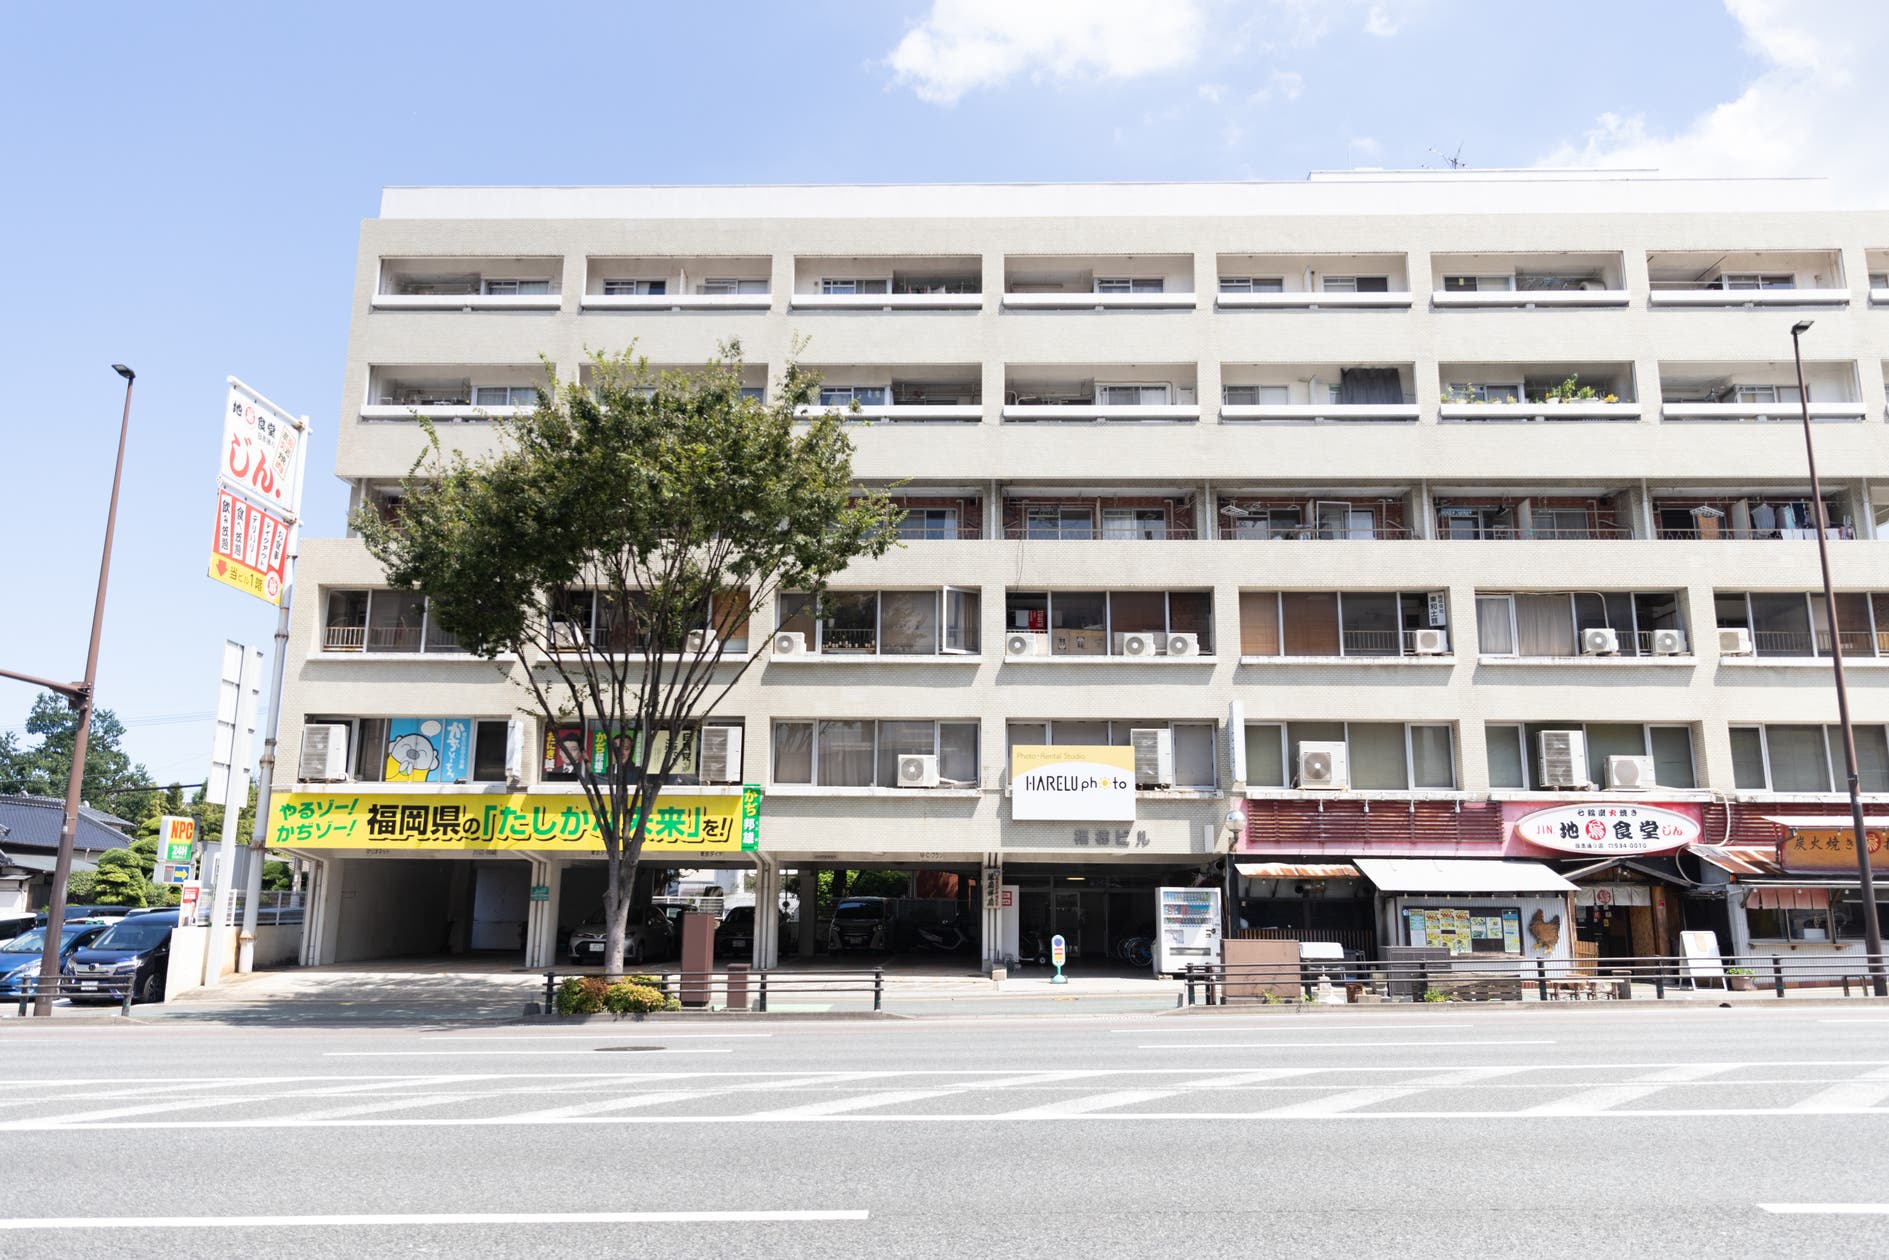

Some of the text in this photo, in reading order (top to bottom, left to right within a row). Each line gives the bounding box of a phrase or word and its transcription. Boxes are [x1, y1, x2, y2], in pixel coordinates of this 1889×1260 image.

[1026, 775, 1078, 791] HARELU
[171, 819, 193, 840] NPC
[172, 845, 187, 857] 24H
[1793, 835, 1854, 851] 炭火焼き
